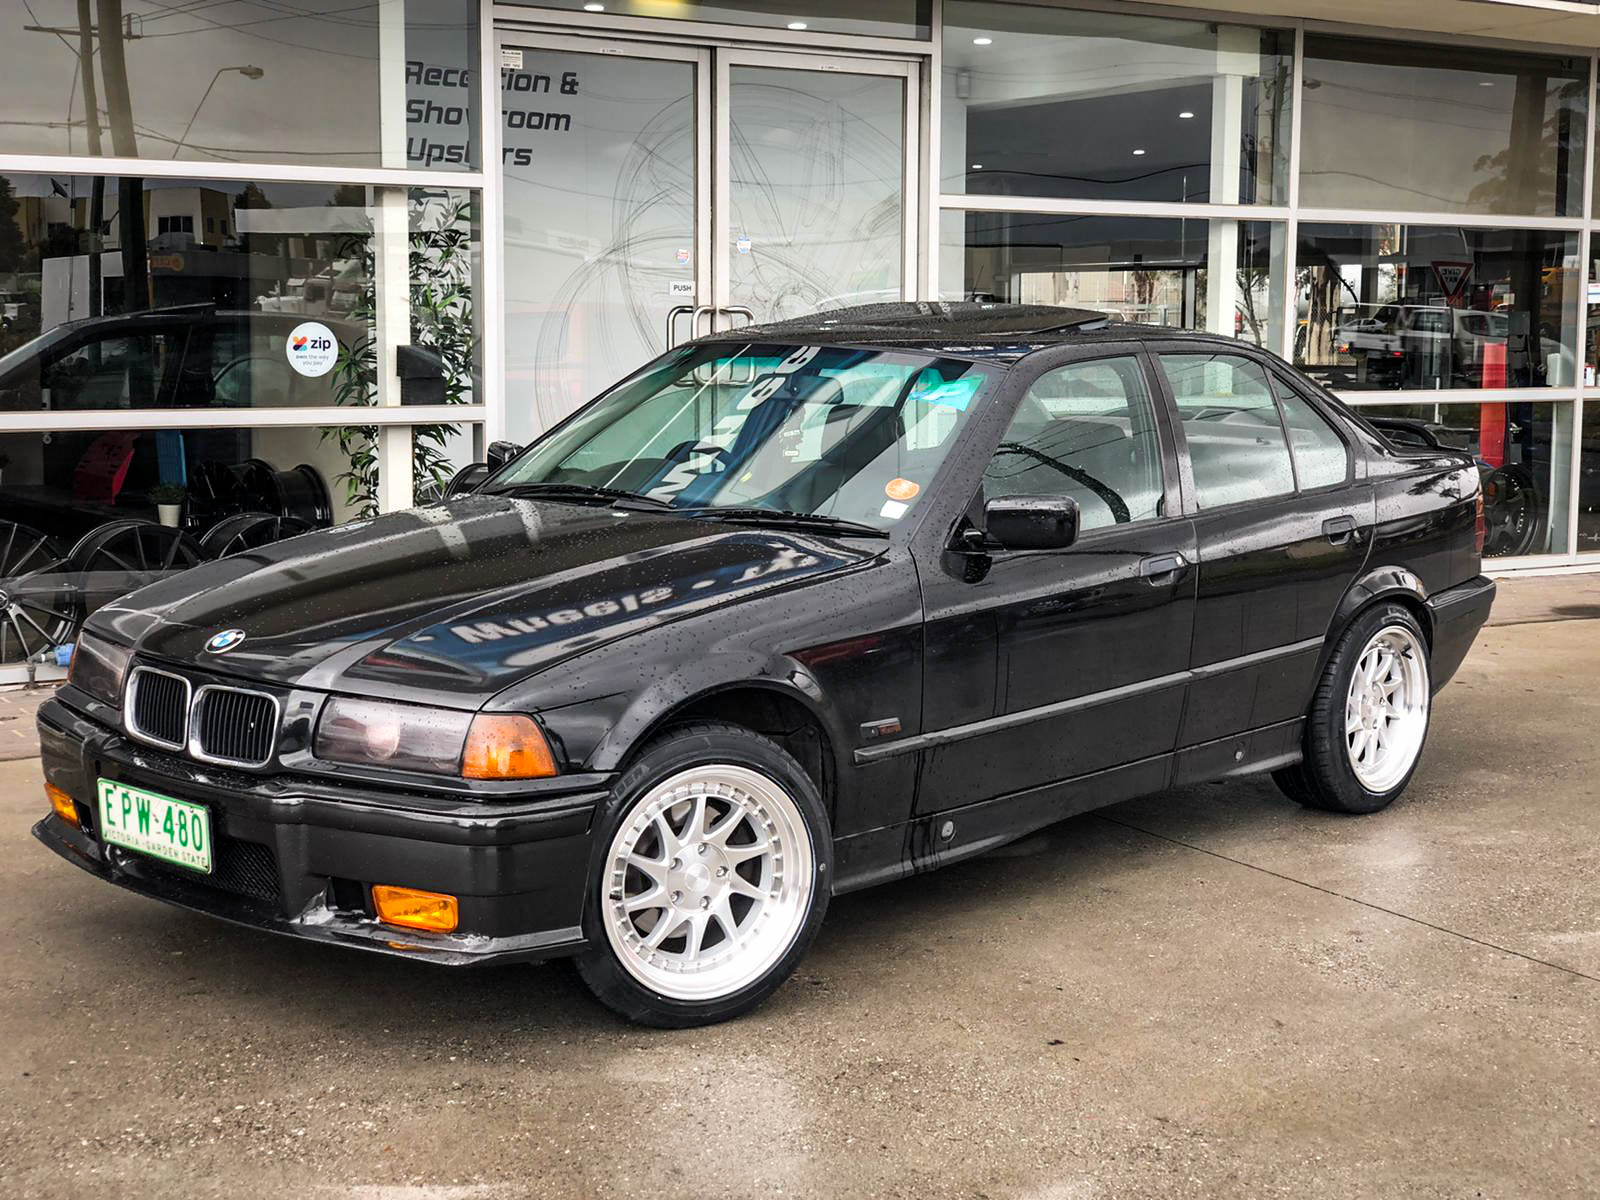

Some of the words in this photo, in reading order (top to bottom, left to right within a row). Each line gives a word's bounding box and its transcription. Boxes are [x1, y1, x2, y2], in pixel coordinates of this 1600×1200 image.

[405, 61, 550, 93] Receion
[560, 72, 579, 95] &
[406, 99, 571, 131] Shooom
[673, 284, 692, 292] PUSH
[310, 336, 331, 351] zip
[182, 850, 206, 867] STATE
